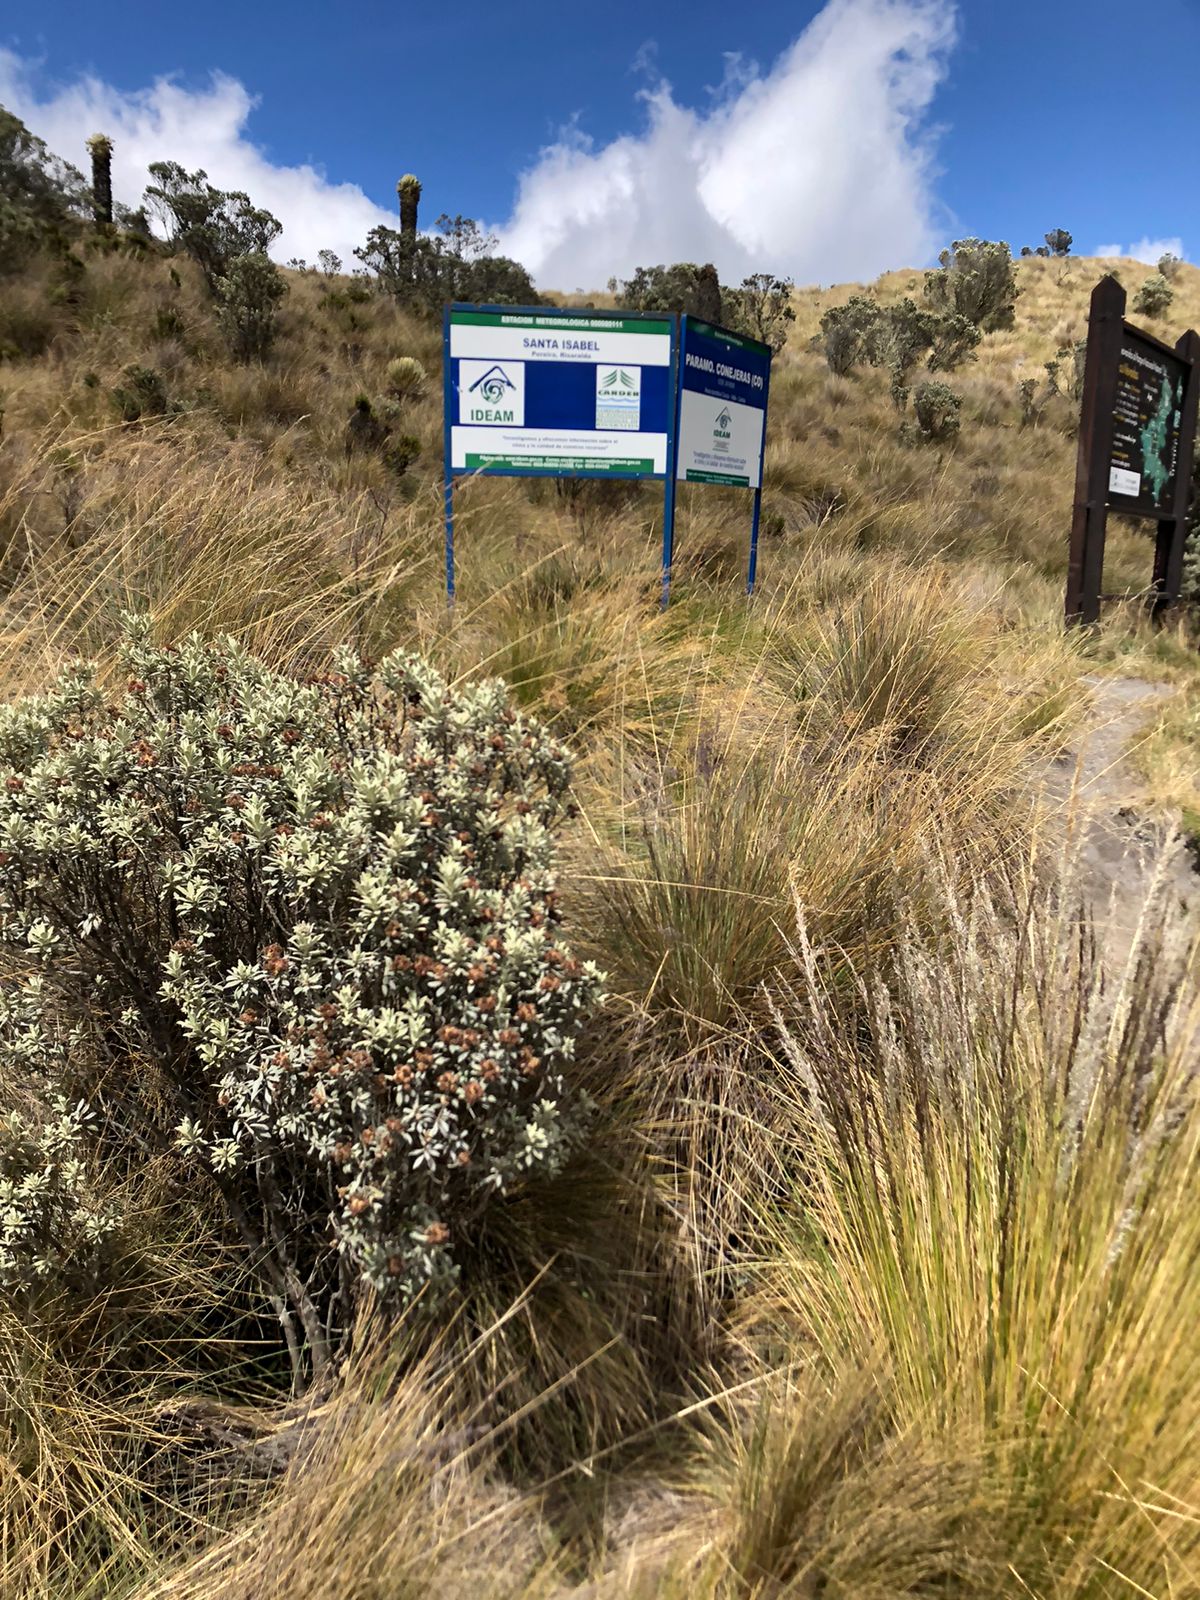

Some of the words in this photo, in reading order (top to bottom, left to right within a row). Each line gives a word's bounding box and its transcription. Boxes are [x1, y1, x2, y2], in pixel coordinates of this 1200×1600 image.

[523, 337, 559, 349] SANTA
[562, 340, 600, 351] ISABEL
[716, 363, 751, 385] CONEJERAS
[751, 374, 764, 390] (CO)
[470, 409, 514, 422] IDEAM
[713, 429, 731, 439] IDEAM
